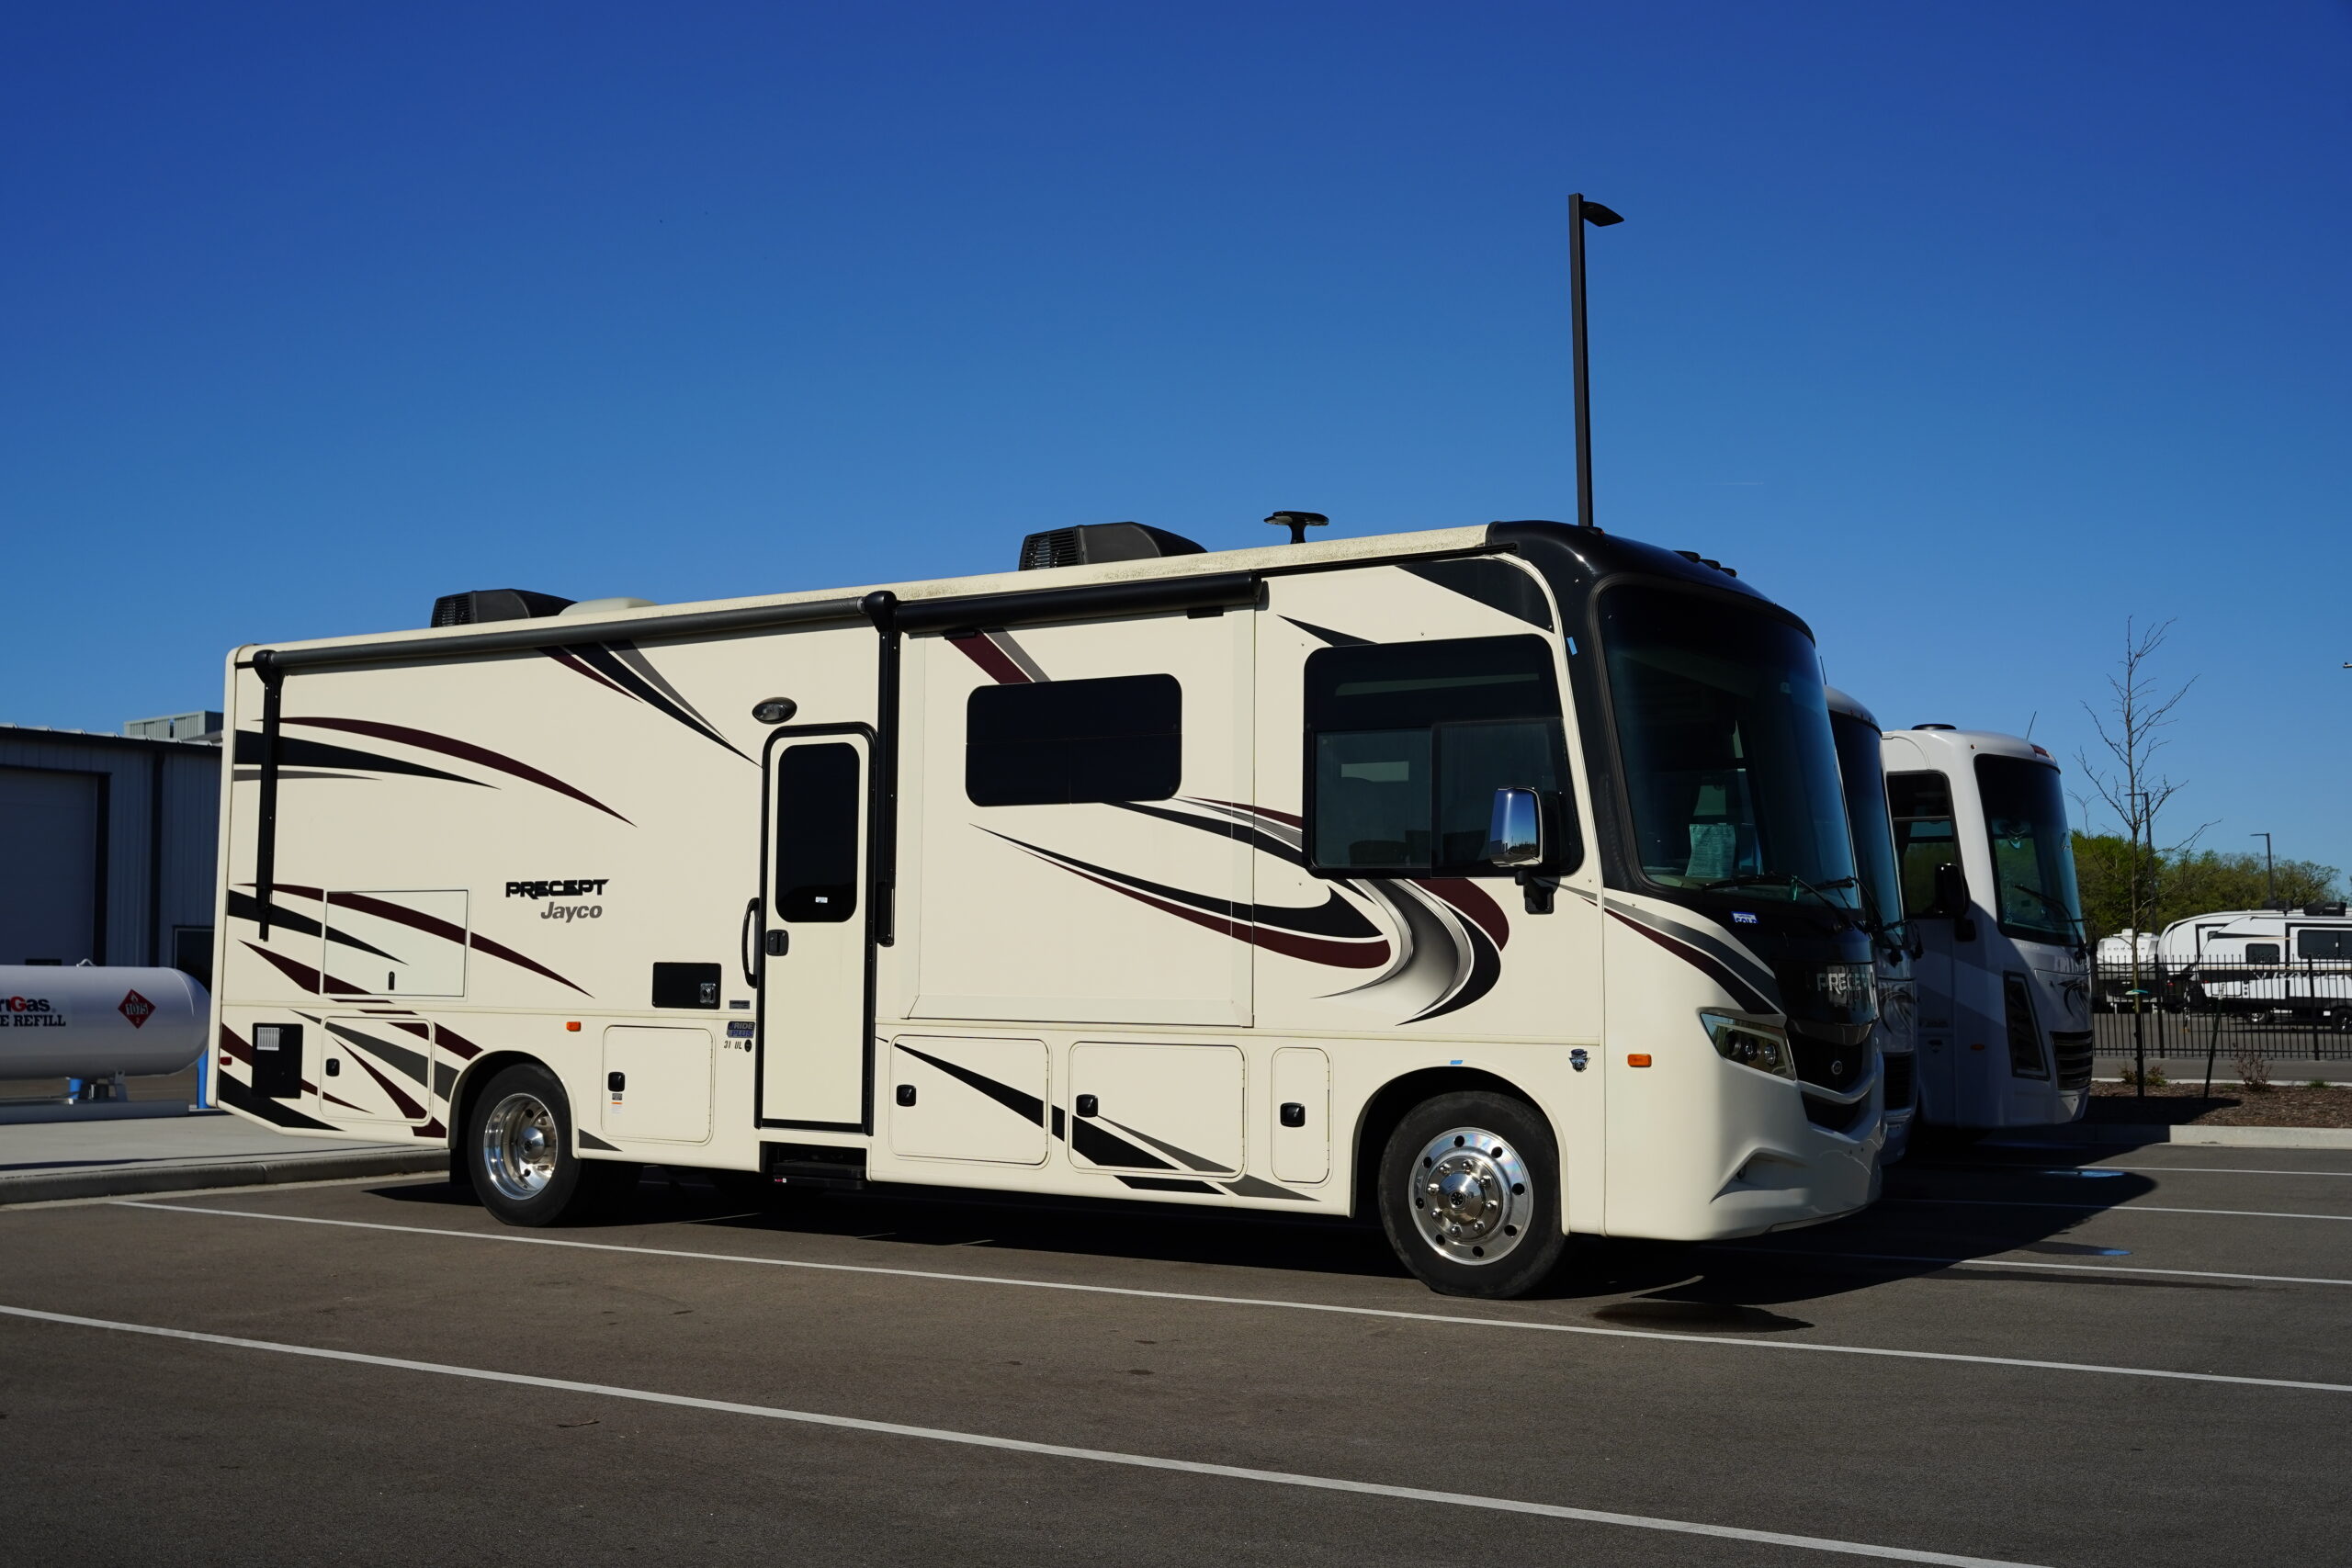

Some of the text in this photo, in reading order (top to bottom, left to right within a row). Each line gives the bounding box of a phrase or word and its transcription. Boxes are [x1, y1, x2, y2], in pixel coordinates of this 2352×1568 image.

[505, 879, 610, 900] PRECEPT
[540, 901, 603, 923] Jayco
[127, 1004, 147, 1014] 1075
[14, 1015, 66, 1027] REFILL
